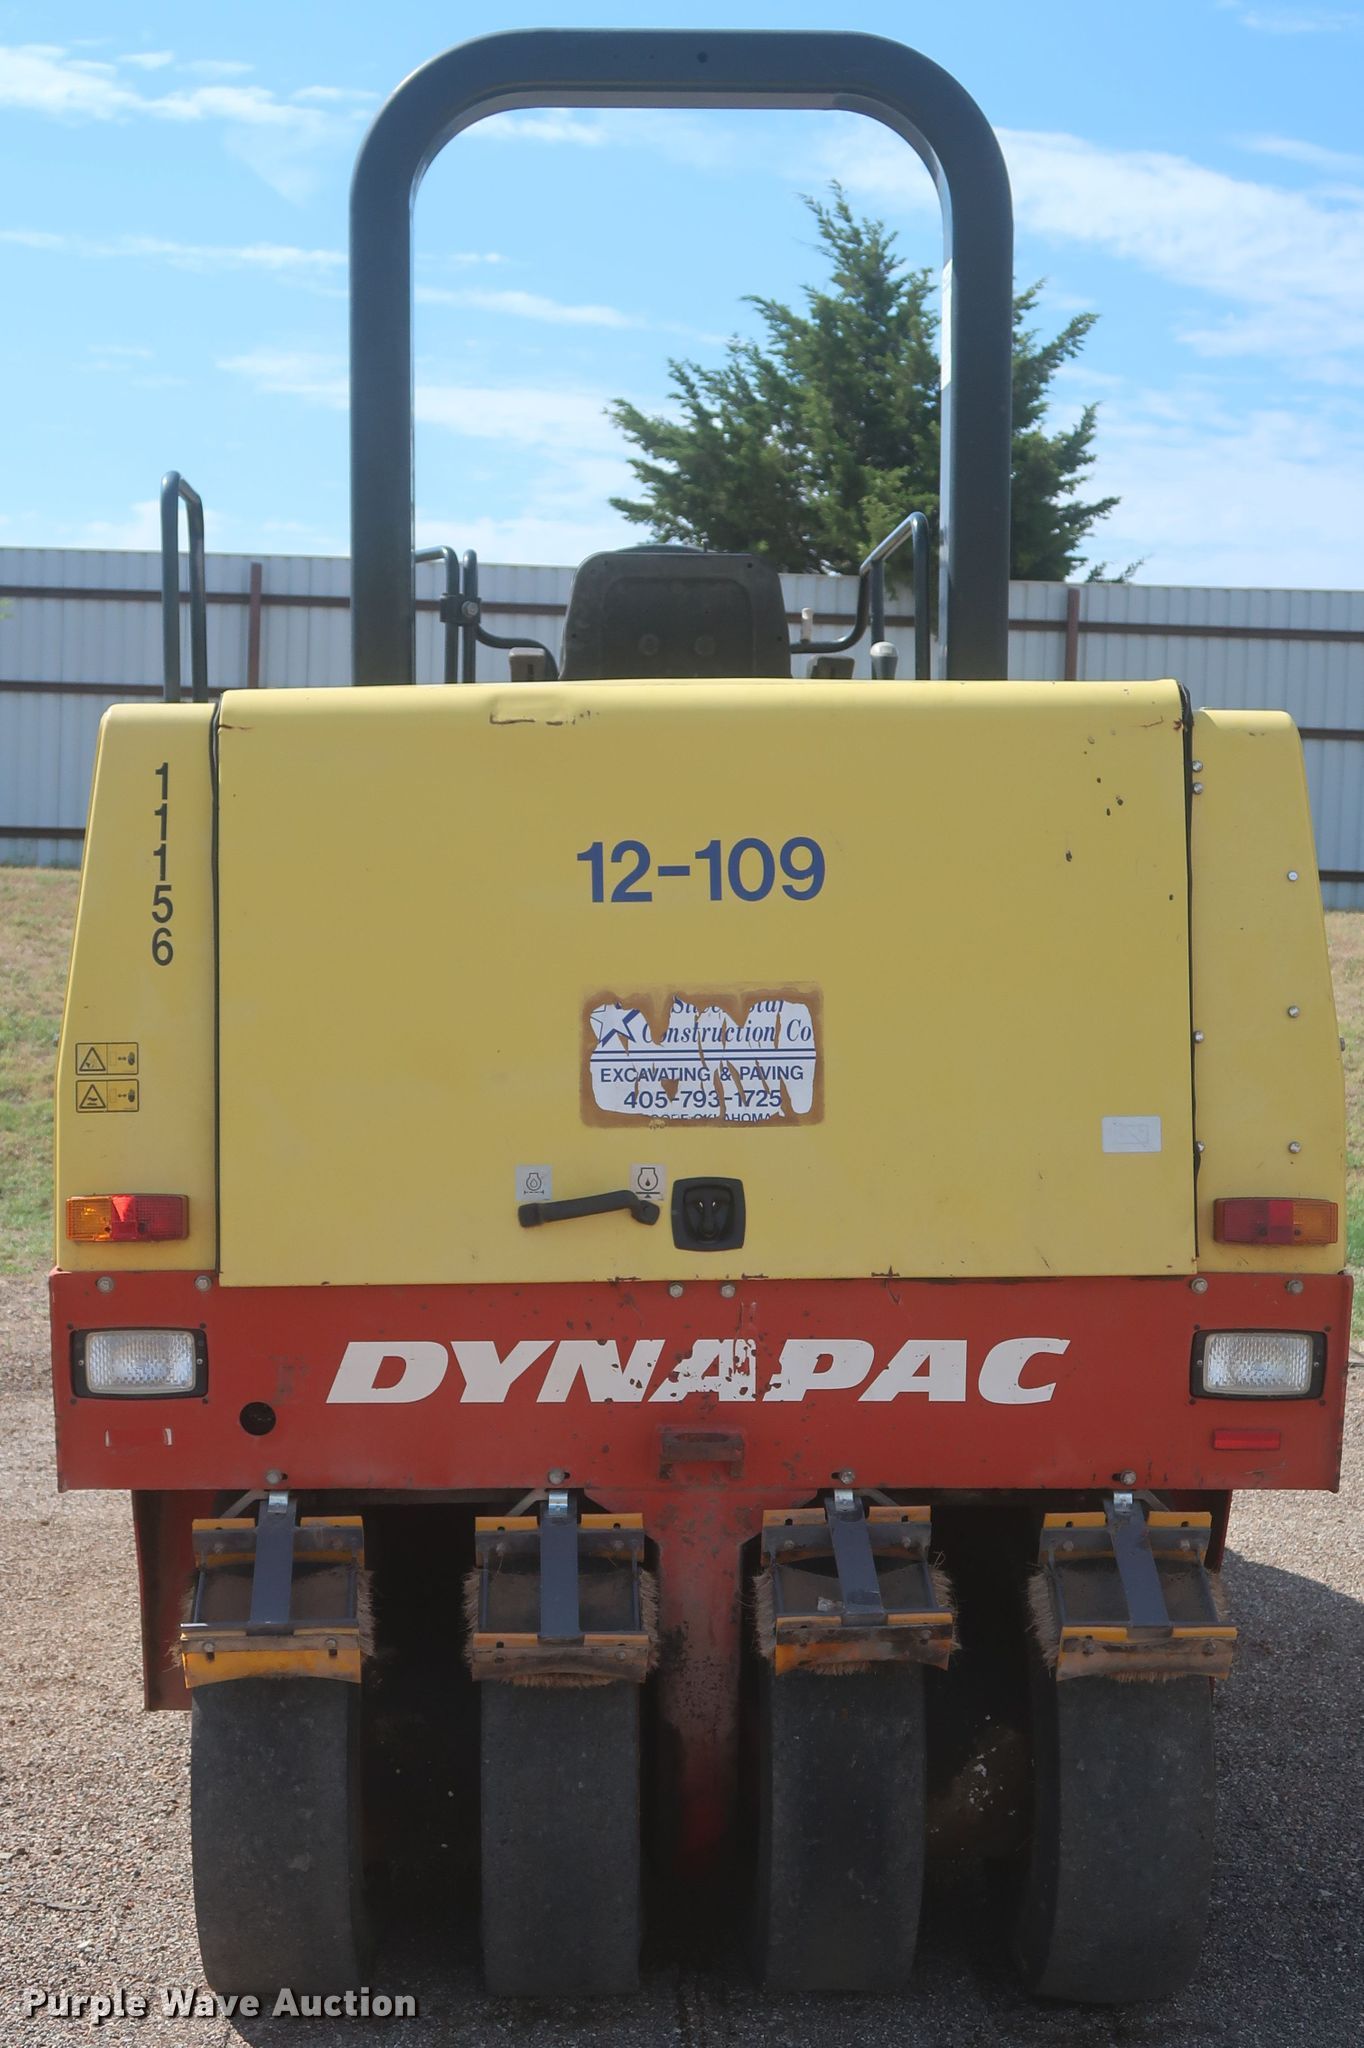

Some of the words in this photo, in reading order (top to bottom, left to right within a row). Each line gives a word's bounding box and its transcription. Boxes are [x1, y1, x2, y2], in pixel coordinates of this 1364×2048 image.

[150, 762, 174, 966] 11156
[576, 836, 826, 903] 12-109
[642, 1018, 776, 1043] Cnstruction
[785, 1018, 812, 1042] Co
[601, 1067, 711, 1082] EXCAVATING
[720, 1067, 731, 1081] &
[739, 1065, 804, 1080] PAVING
[623, 1089, 782, 1109] 405-793-1725
[325, 1337, 1071, 1404] DYNAPAC
